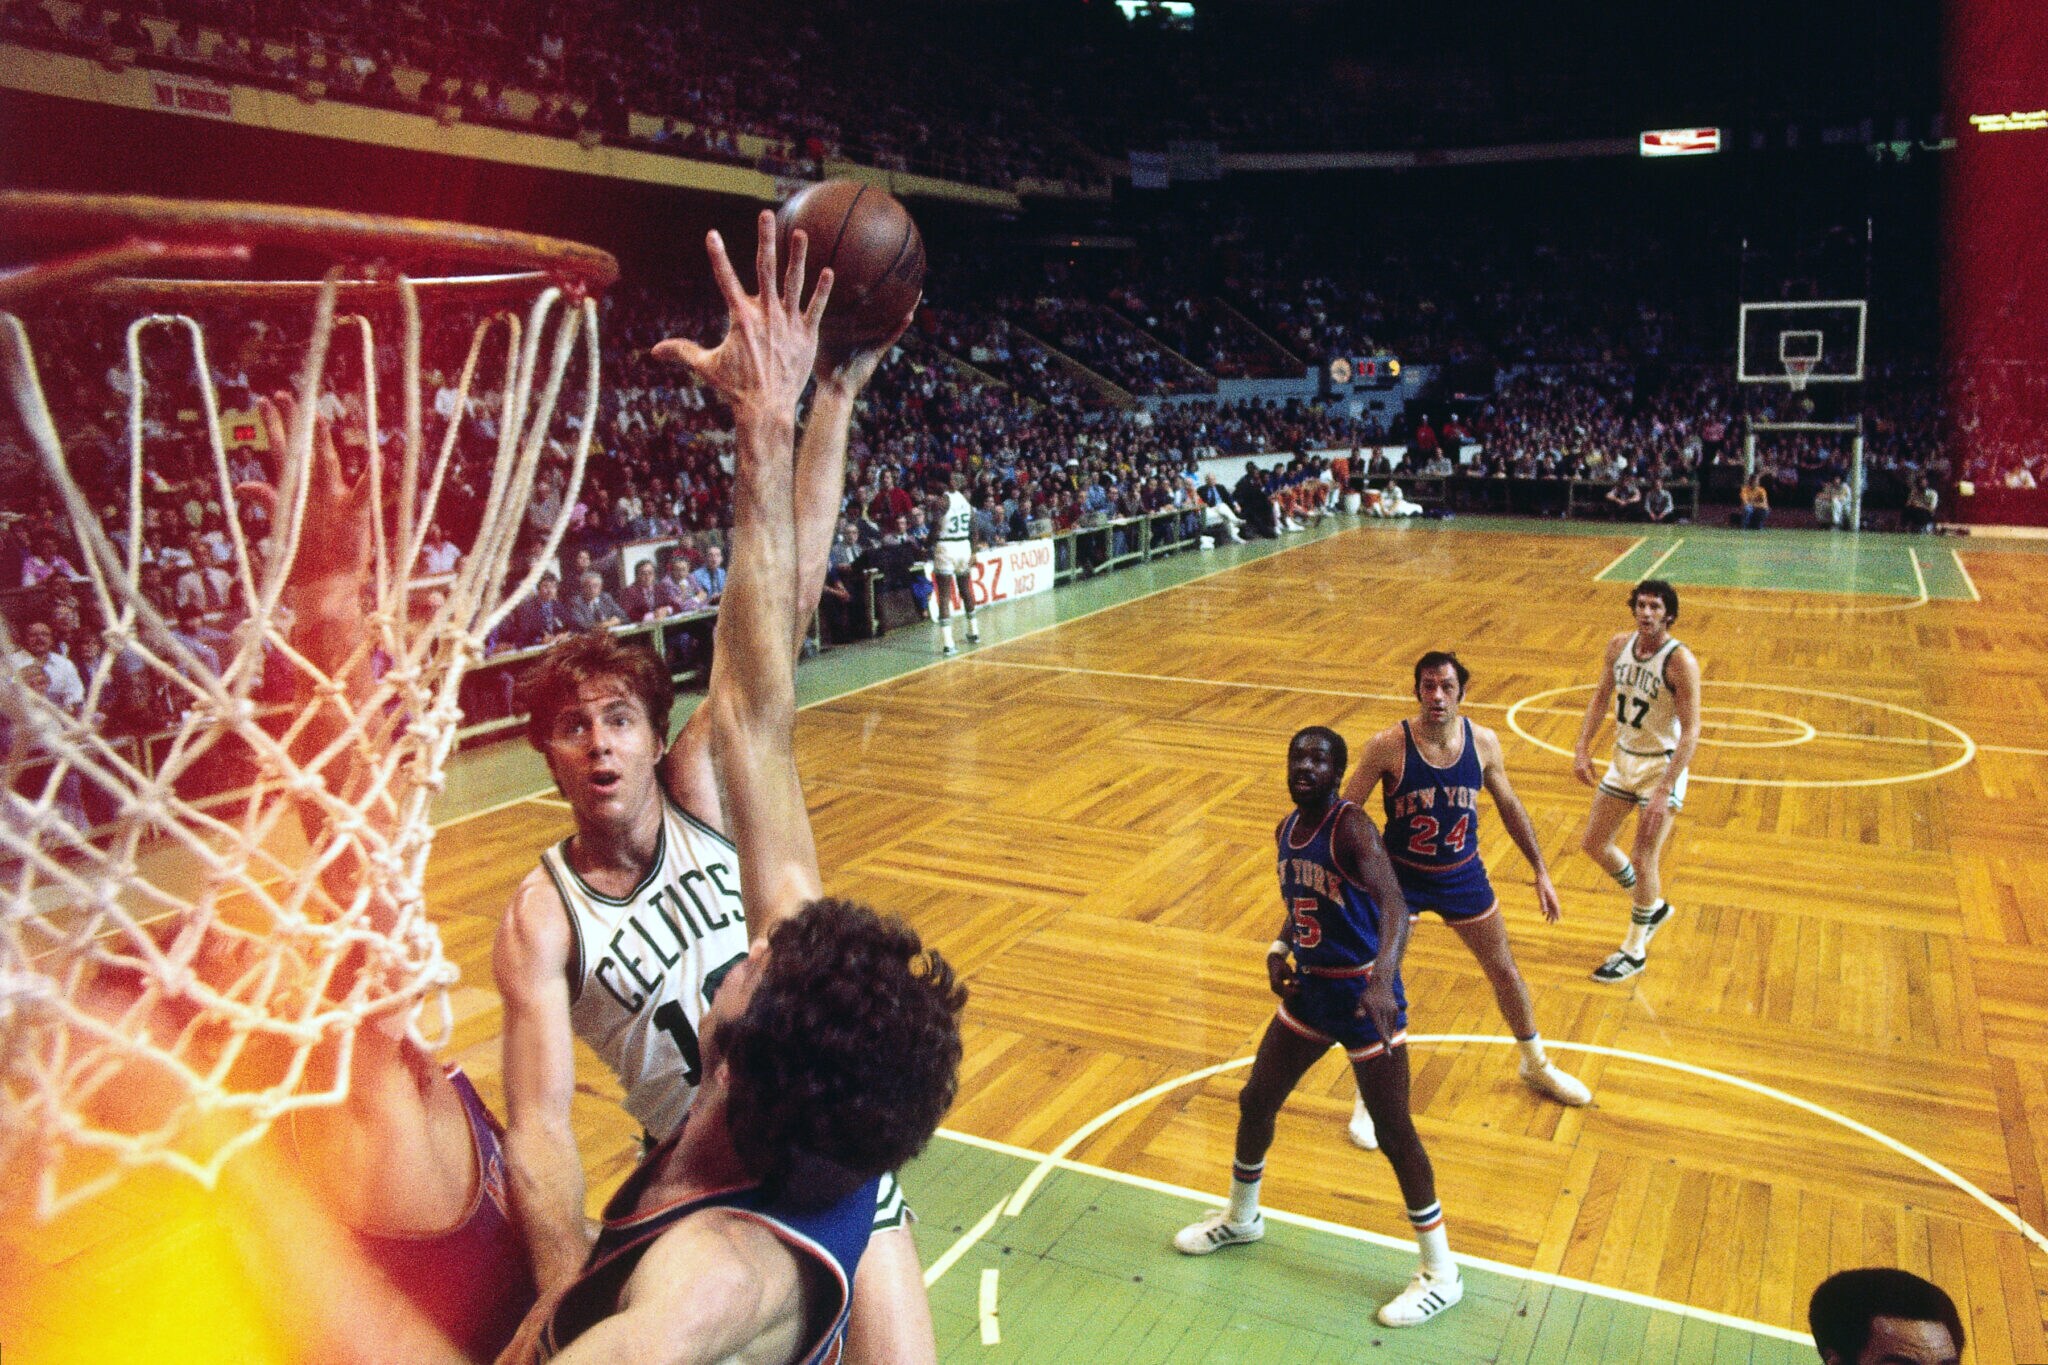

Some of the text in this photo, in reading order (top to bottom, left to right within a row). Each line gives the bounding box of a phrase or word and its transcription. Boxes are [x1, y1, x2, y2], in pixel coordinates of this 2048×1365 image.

[949, 513, 969, 533] 35
[1010, 547, 1049, 571] RADIO
[1617, 693, 1649, 729] 17
[1395, 787, 1435, 818] NEW
[1408, 813, 1469, 855] 24
[595, 863, 747, 1013] CELTICS
[653, 952, 749, 1087] 1
